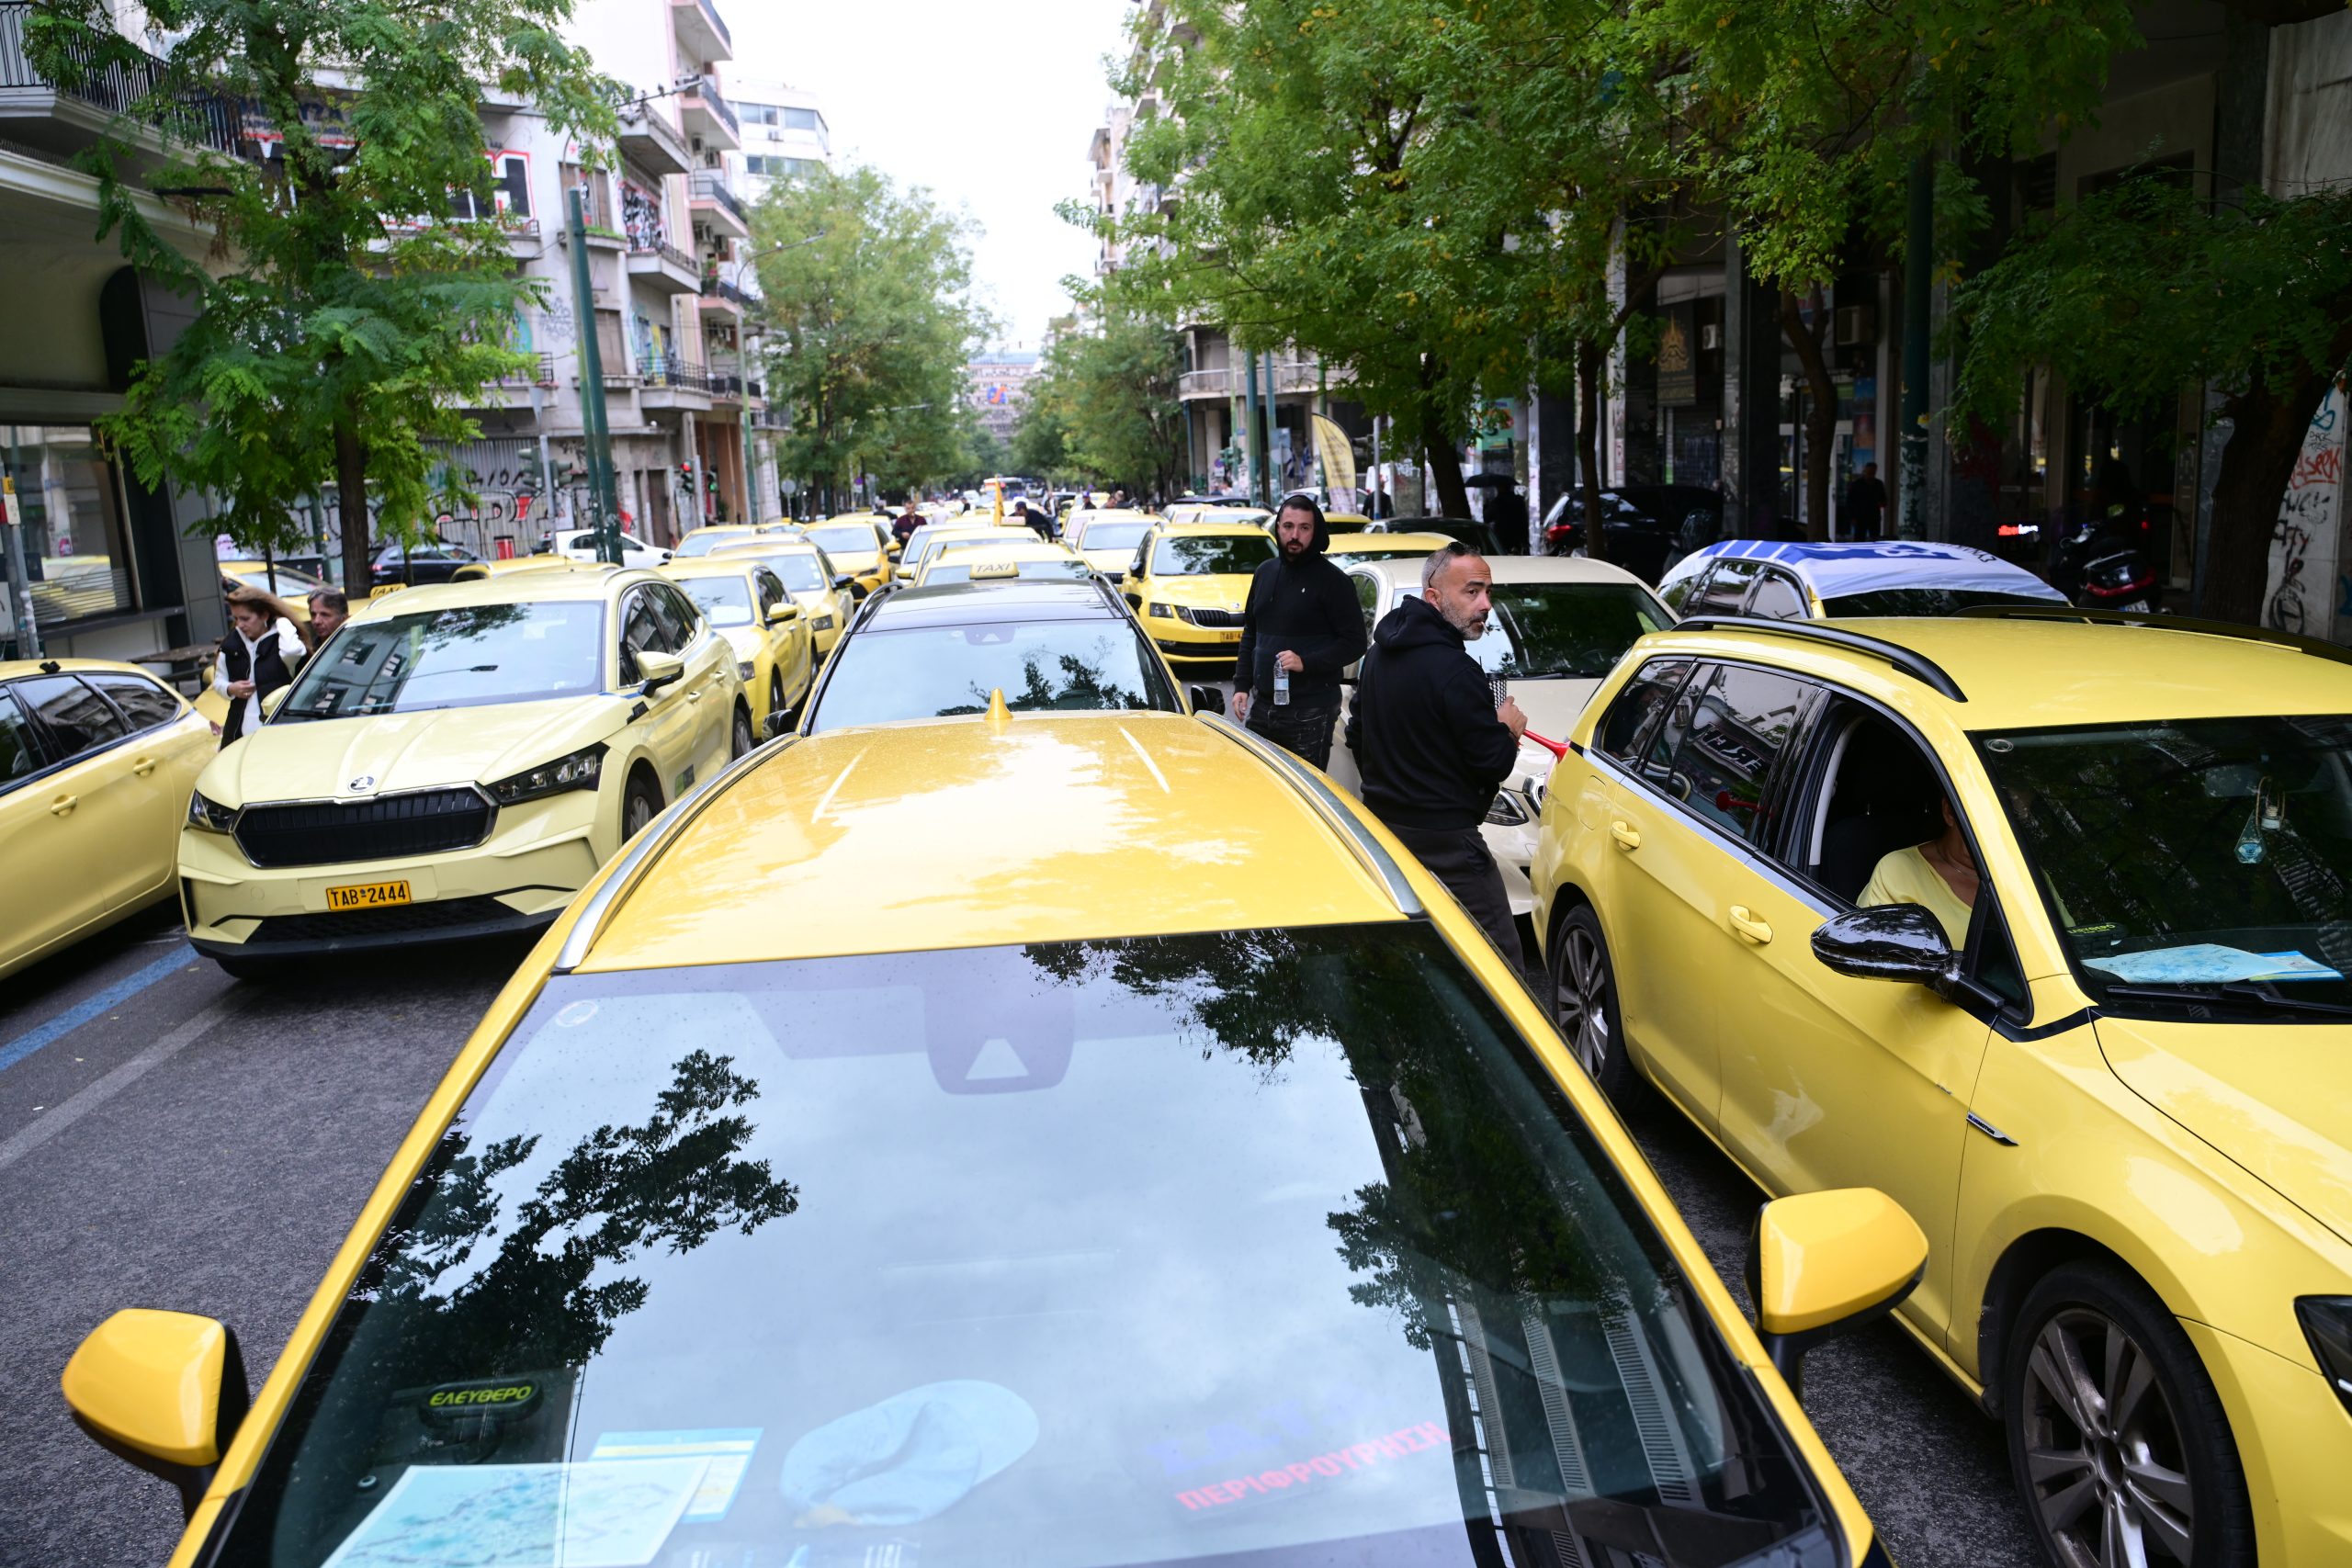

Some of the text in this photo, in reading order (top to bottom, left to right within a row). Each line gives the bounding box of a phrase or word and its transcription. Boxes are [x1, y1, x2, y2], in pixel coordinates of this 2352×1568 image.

[977, 563, 1011, 572] TAXI
[429, 1385, 532, 1406] ΕΛΕΥΘΕΡΟ
[1175, 1420, 1454, 1511] ΠΕΡΙΦΡΟΥΡΗΣΗ
